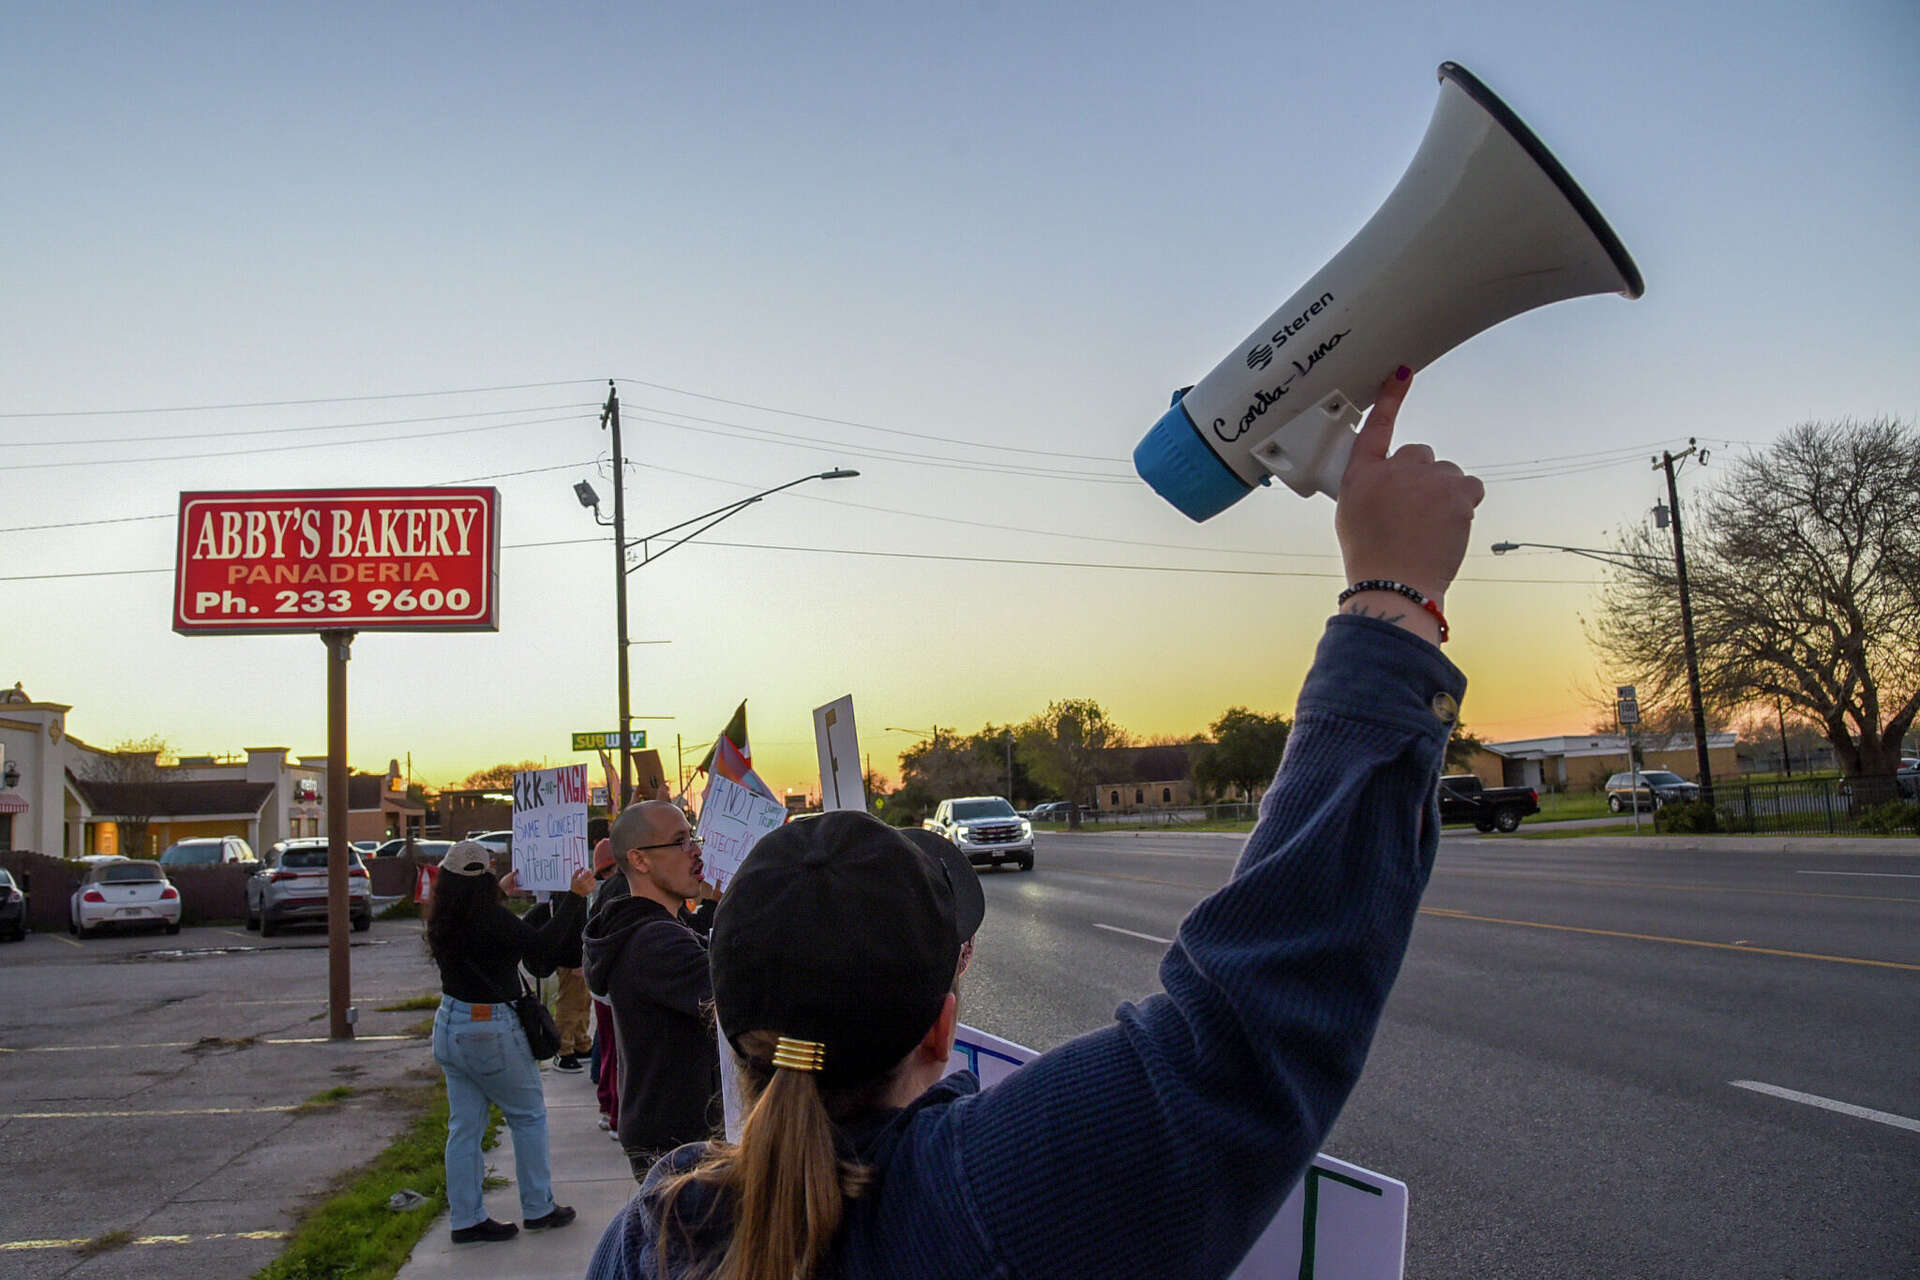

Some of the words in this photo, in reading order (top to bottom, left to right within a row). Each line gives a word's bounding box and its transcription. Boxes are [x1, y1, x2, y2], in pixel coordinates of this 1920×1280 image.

[1271, 292, 1335, 348] Steren
[192, 507, 321, 559] ABBY'S
[328, 508, 478, 558] BAKERY
[228, 562, 439, 585] PANADERIA
[196, 590, 259, 614] Ph.
[275, 590, 352, 613] 233
[367, 588, 471, 611] 9600
[575, 732, 643, 749] SUBWY
[513, 771, 544, 814] KKK
[557, 765, 586, 805] MAGA
[723, 782, 759, 822] NOT
